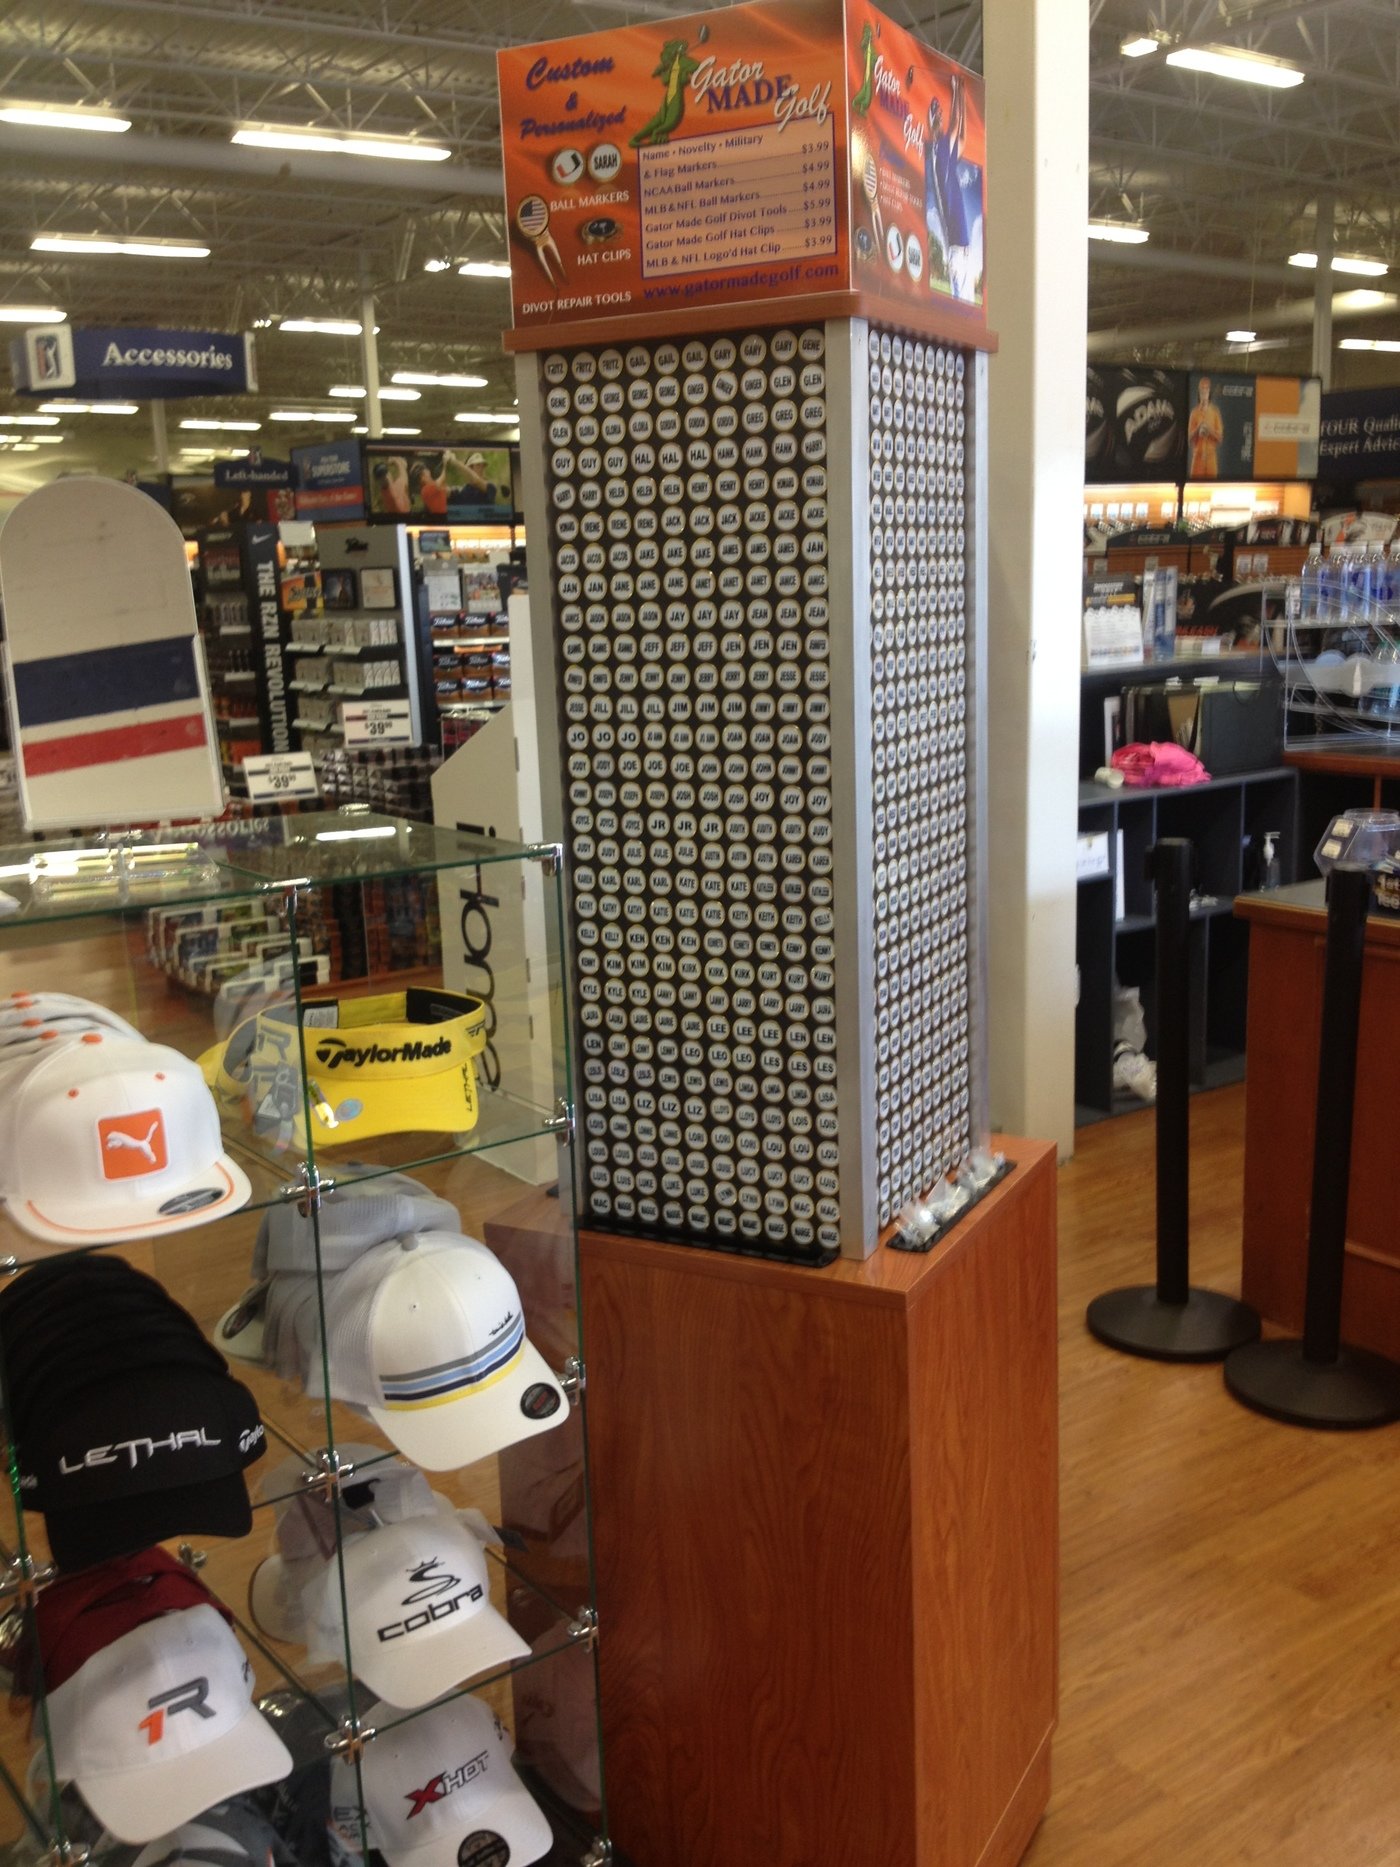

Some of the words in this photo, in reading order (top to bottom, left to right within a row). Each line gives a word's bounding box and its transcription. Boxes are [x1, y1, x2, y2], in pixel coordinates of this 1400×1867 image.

[525, 56, 615, 91] Custom
[690, 55, 764, 103] Gator
[874, 55, 901, 95] Gator
[707, 74, 793, 113] MADE
[773, 80, 832, 133] Golf
[520, 105, 627, 140] Personalized
[903, 113, 925, 158] Golf
[643, 148, 670, 161] Name
[678, 141, 716, 156] Novelty
[725, 134, 763, 148] Military
[593, 153, 618, 170] SARAH
[654, 167, 675, 178] Flag
[677, 160, 717, 174] Markers
[802, 141, 829, 154] $3.99
[643, 186, 674, 198] NCAA
[674, 181, 693, 193] Ball
[695, 177, 735, 190] Markers
[802, 161, 830, 174] $4.99
[550, 199, 576, 212] BALL
[579, 190, 630, 208] MARKERS
[644, 205, 667, 216] MLB
[699, 196, 718, 208] Ball
[720, 191, 760, 204] Markers
[802, 179, 830, 192] $4.99
[645, 221, 673, 233] Gator
[676, 216, 702, 230] Made
[705, 212, 726, 225] Golf
[729, 210, 756, 221] Divot
[761, 204, 787, 216] Tools
[803, 198, 831, 211] $5.99
[646, 239, 673, 251] Gator
[676, 234, 702, 247] Made
[705, 229, 727, 242] Golf
[730, 227, 747, 238] Hat
[750, 223, 775, 236] Clips
[804, 216, 832, 229] $3.99
[577, 253, 598, 266] HAT
[602, 249, 632, 262] CLIPS
[646, 257, 668, 269] MLB
[740, 244, 758, 255] Hat
[761, 241, 781, 254] Clip
[805, 236, 832, 249] $3.99
[643, 263, 839, 300] www.gatormadegolf.com
[522, 301, 554, 315] DIVOT
[557, 296, 593, 310] REPAIR
[596, 291, 632, 304] TOOLS
[102, 341, 233, 370] Accessories
[634, 453, 652, 464] HAL
[662, 452, 679, 464] HAL
[690, 449, 708, 461] HAL
[555, 458, 571, 469] GUY
[581, 458, 597, 469] GUY
[607, 457, 624, 468] GUY
[224, 469, 289, 482] Left-handed
[806, 542, 824, 553] JAN
[257, 560, 276, 597] THE
[562, 583, 578, 594] JAN
[588, 582, 604, 593] JAN
[260, 602, 280, 638] RZN
[670, 611, 686, 622] JAY
[697, 610, 713, 621] JAY
[723, 610, 740, 621] JAY
[725, 641, 742, 653] JEN
[753, 639, 770, 651] JEN
[780, 640, 798, 651] JEN
[264, 644, 289, 752] REVOLUTION
[571, 731, 586, 743] JO
[621, 732, 637, 742] JO
[622, 760, 638, 771] JOE
[674, 762, 690, 773] JOE
[784, 794, 800, 805] JOY
[811, 795, 827, 806] JOY
[629, 933, 645, 944] KEN
[655, 935, 671, 945] KEN
[630, 959, 646, 969] KIM
[656, 961, 672, 972] KIM
[710, 1023, 727, 1034] LEE
[736, 1026, 753, 1037] LEE
[315, 1036, 452, 1069] TaylorMade
[636, 1098, 652, 1109] LIZ
[661, 1102, 677, 1113] LIZ
[58, 1426, 222, 1476] LETHAL
[377, 1583, 484, 1643] cobra
